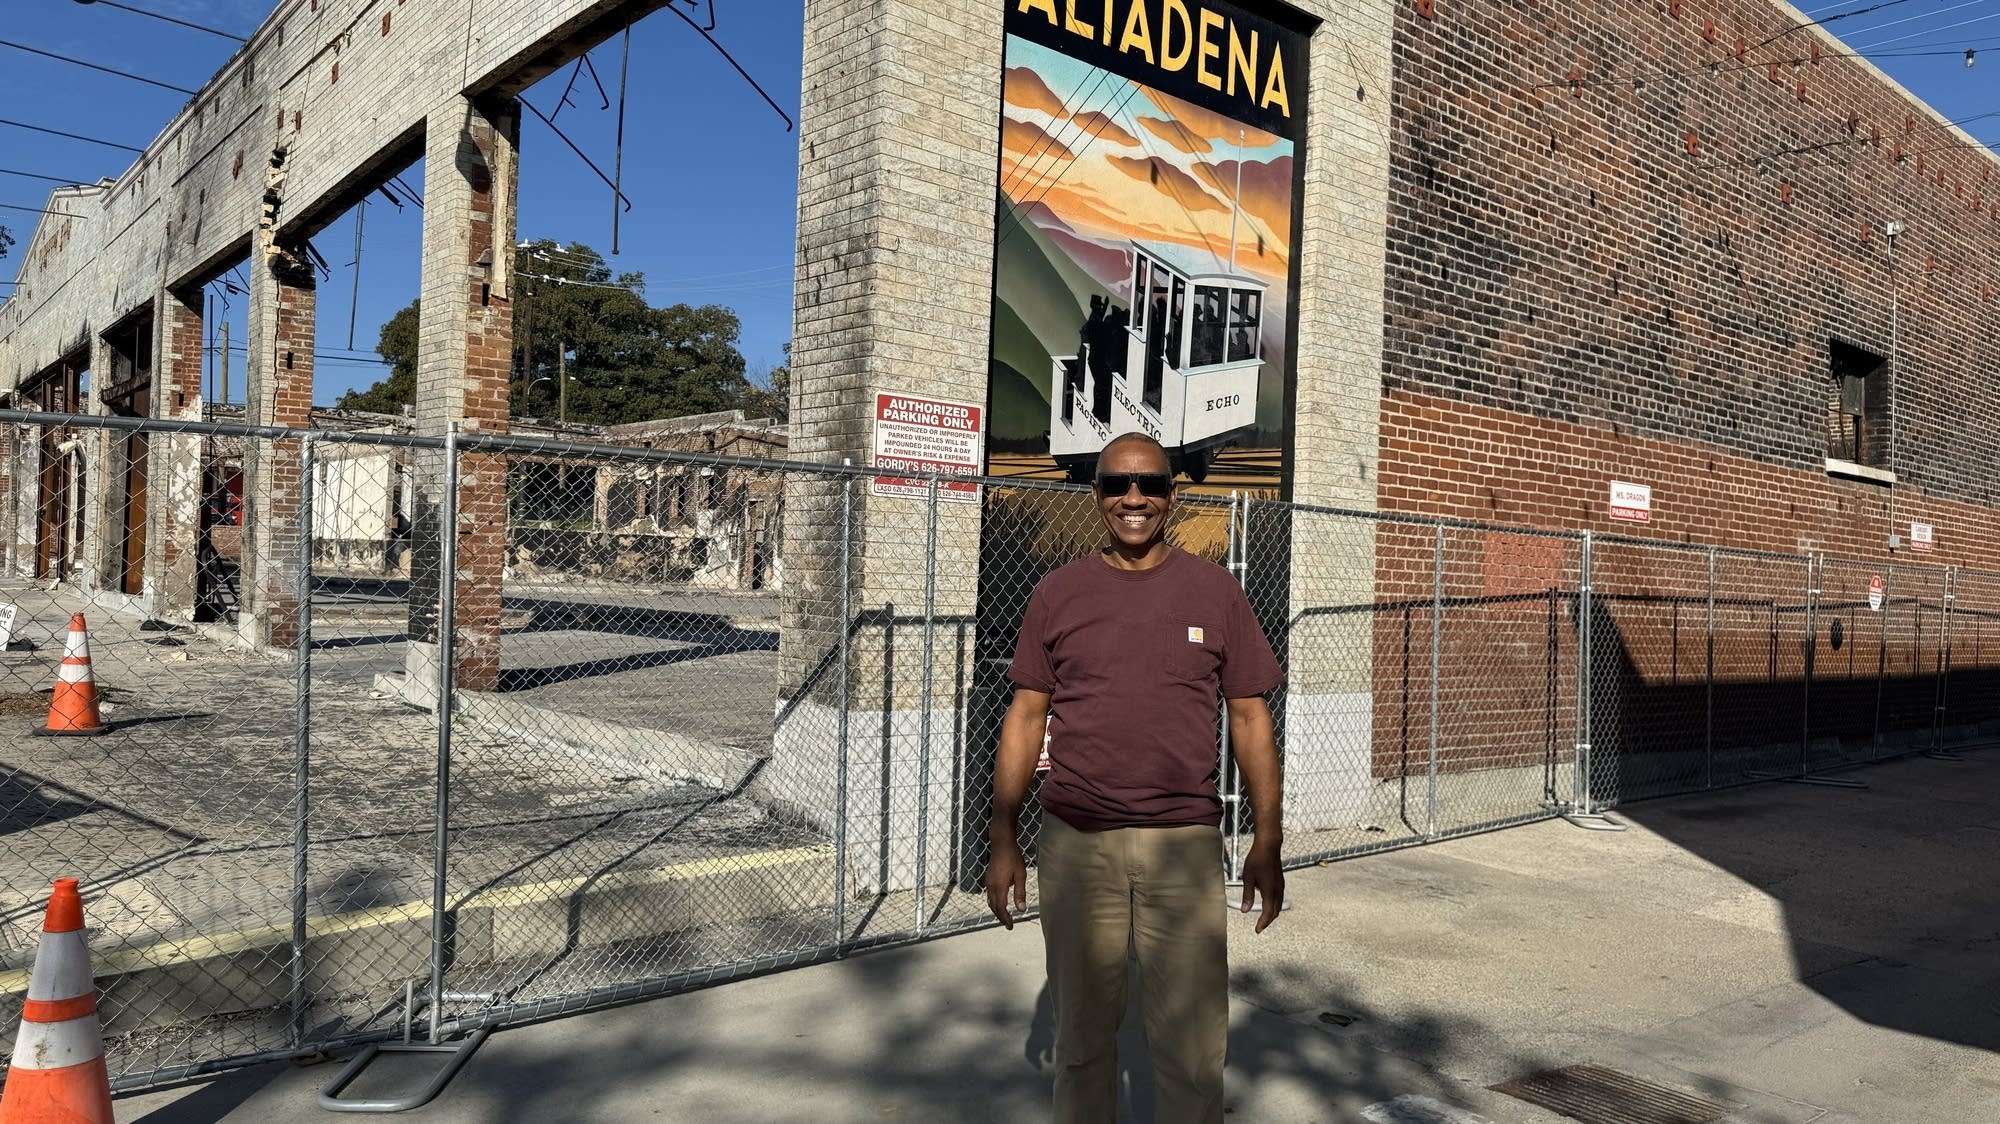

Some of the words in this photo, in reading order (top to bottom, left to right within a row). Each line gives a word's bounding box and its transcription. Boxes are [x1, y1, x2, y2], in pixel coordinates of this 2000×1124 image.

[1018, 0, 1290, 118] LADENA
[889, 398, 969, 419] AUTHORIZED
[1205, 394, 1240, 412] ECHO
[883, 408, 939, 426] PARKING
[942, 416, 975, 430] ONLY
[1075, 396, 1107, 441] PACIFIC
[1114, 385, 1161, 442] ELECTRIC
[879, 422, 928, 434] UNAUTHORIZED
[939, 430, 977, 440] IMPROPERLY
[888, 431, 914, 440] PARKED
[914, 434, 944, 444] VEHICLES
[945, 438, 959, 446] WILL
[884, 439, 922, 449] IMPOUNDED
[931, 444, 953, 453] HOURS
[959, 447, 972, 455] DAY
[893, 448, 922, 457] OWNER'S
[923, 451, 938, 459] RISK
[944, 453, 971, 462] EXPENSE
[876, 457, 919, 472] GORDY'S
[921, 462, 977, 476] 626-797-6591
[1612, 507, 1635, 519] PARKING
[1635, 510, 1648, 520] ONLY
